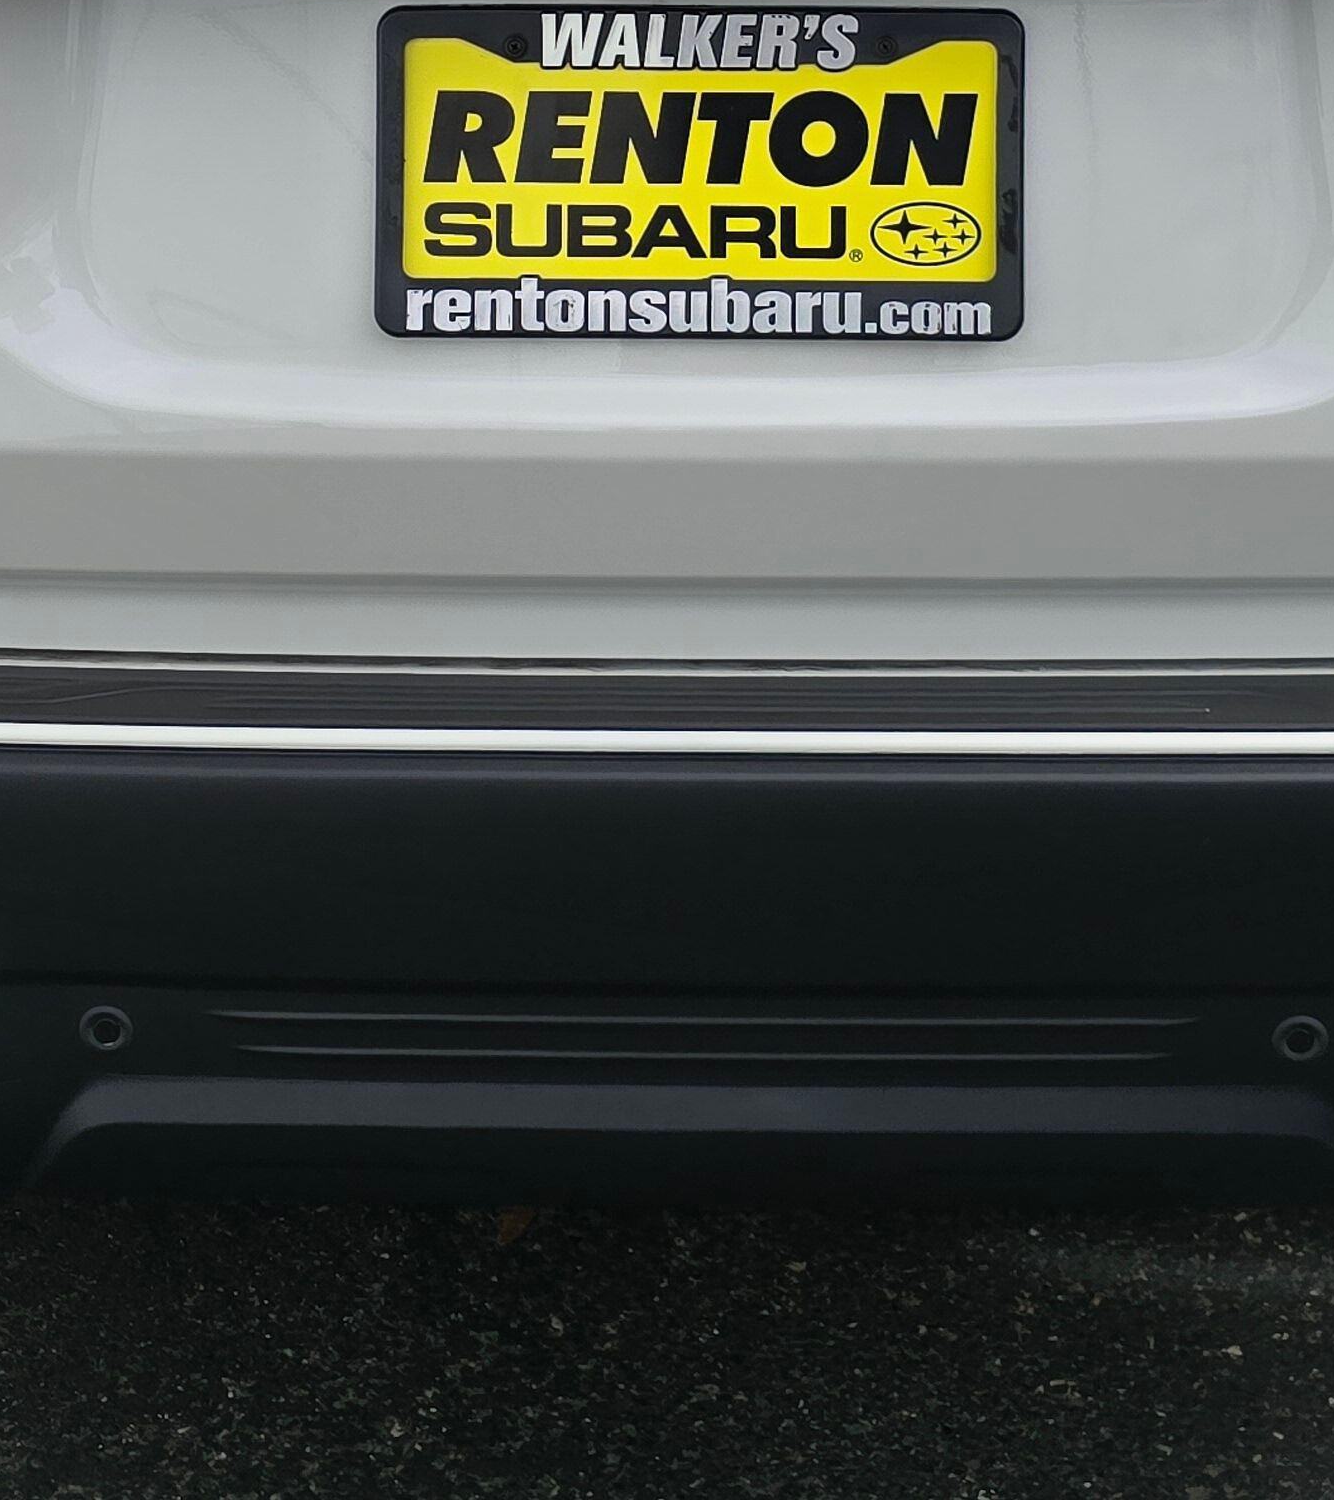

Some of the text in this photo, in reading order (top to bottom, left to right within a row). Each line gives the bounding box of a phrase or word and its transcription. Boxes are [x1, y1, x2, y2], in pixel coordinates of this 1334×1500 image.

[541, 13, 859, 70] WALKER'S
[423, 90, 979, 188] RENTON
[405, 277, 992, 336] rentonsubaru.com
